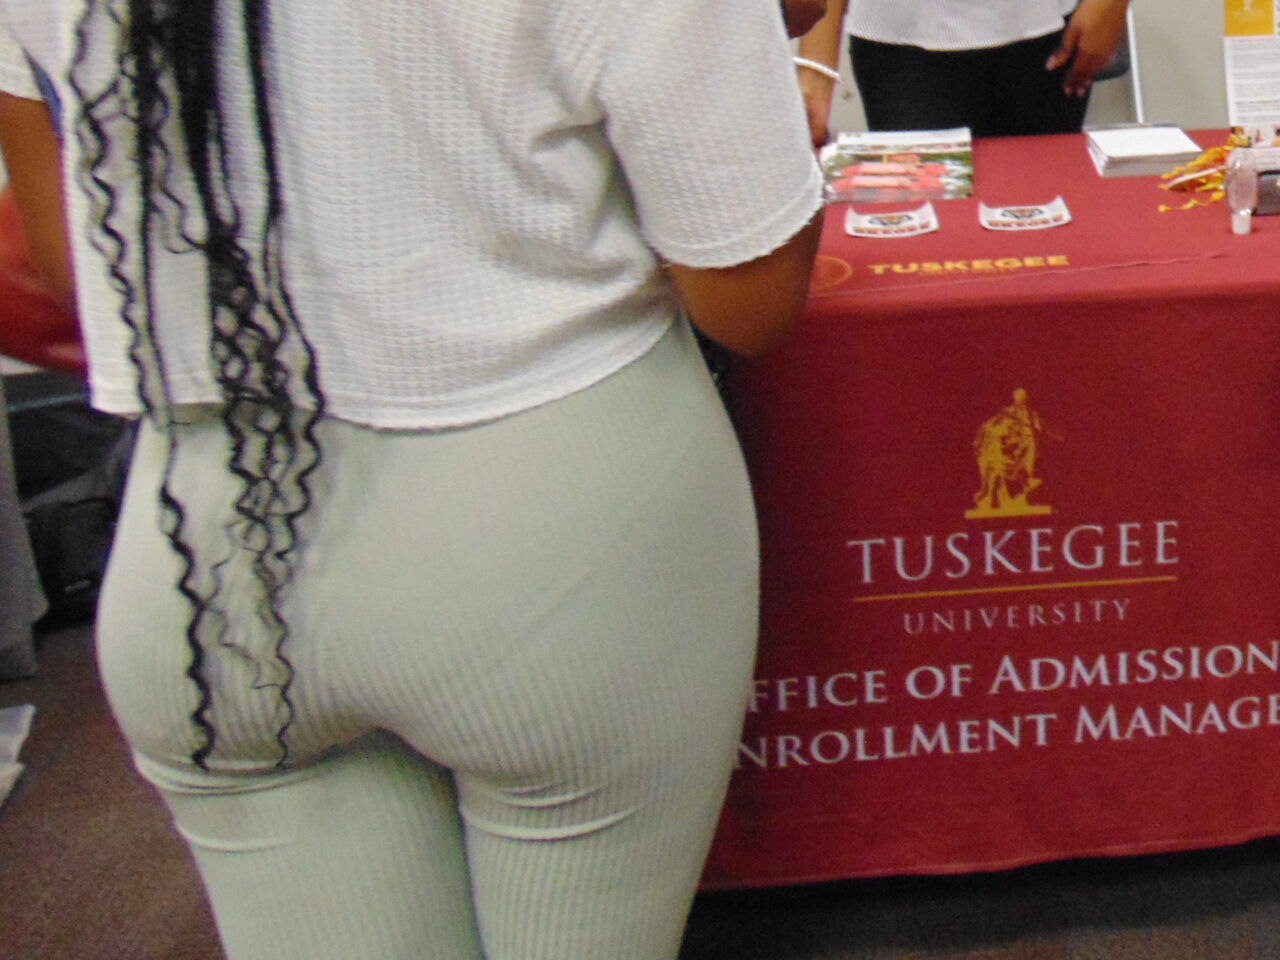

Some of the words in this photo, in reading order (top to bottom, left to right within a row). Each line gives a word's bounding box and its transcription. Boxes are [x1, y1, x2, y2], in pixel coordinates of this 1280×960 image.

[868, 255, 1070, 274] TUSKEGEE
[847, 521, 1179, 583] TUSKEGEE
[904, 599, 1130, 634] UNIVERSITY
[750, 670, 888, 712] FFICE
[905, 665, 973, 699] OF
[738, 714, 1057, 768] NROLLMENT
